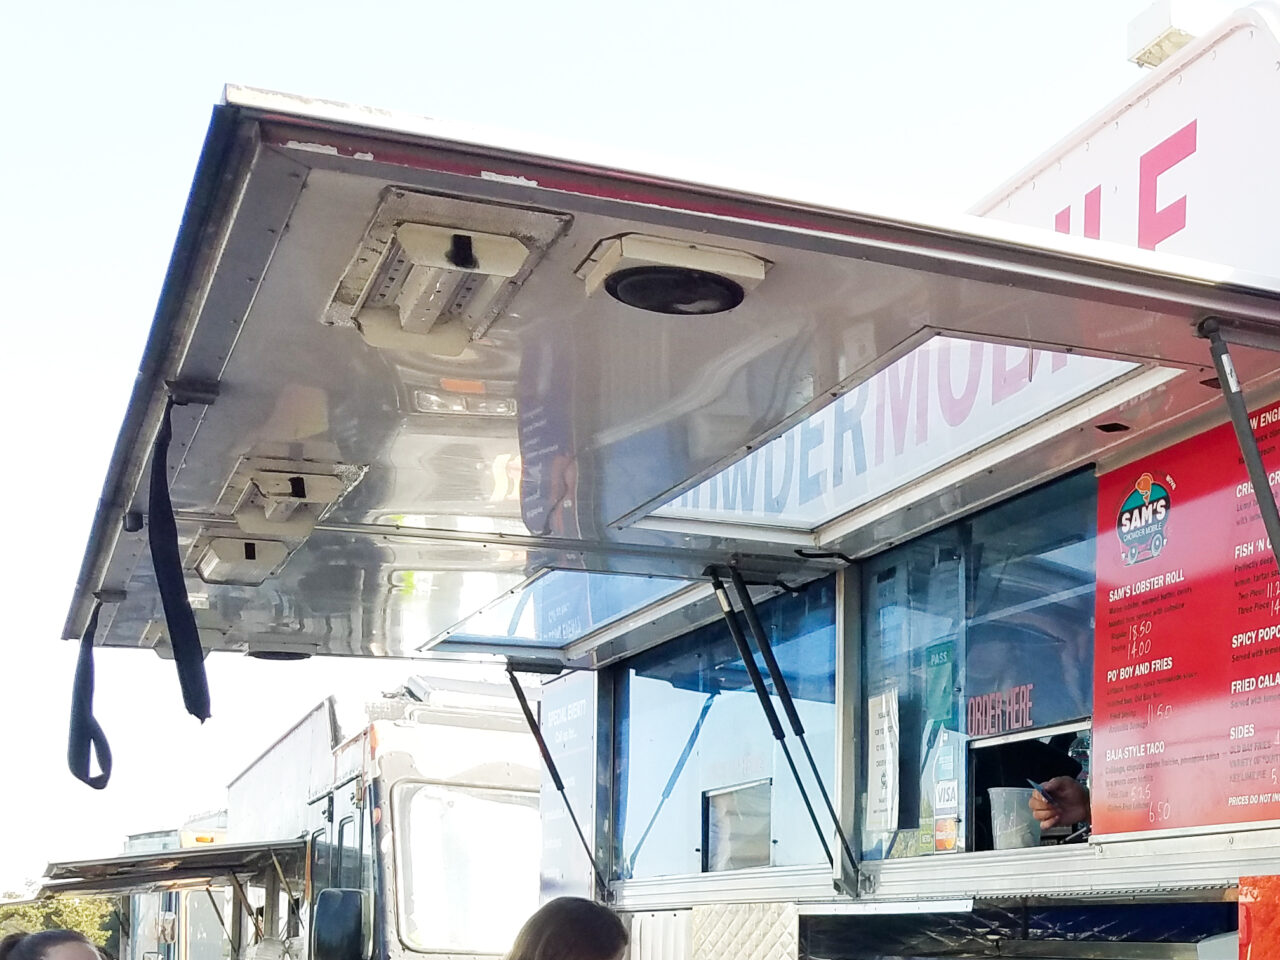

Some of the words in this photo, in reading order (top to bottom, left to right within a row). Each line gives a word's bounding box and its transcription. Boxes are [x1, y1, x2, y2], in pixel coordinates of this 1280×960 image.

[1121, 499, 1166, 533] SAM'S
[1235, 543, 1254, 559] FISH
[1109, 585, 1131, 603] SAM'S
[1132, 575, 1164, 596] LOBSTER
[1165, 568, 1184, 586] ROLL
[1129, 620, 1152, 642] 18.50
[1231, 630, 1257, 649] SPICY
[930, 650, 948, 666] PASS
[1107, 669, 1119, 683] PO'
[1120, 665, 1135, 680] BOY
[1135, 662, 1151, 677] AND
[1151, 656, 1173, 673] FRIES
[1231, 677, 1256, 695] FRIED
[968, 691, 1002, 738] ORDER
[1005, 683, 1034, 731] HERE
[1230, 724, 1255, 740] SIDES
[1106, 743, 1146, 762] BAJA-STYLE
[1146, 740, 1165, 755] TACO
[938, 787, 956, 803] VISA
[1228, 795, 1249, 806] PRICES
[1249, 794, 1258, 804] DO
[1259, 793, 1272, 804] NOT
